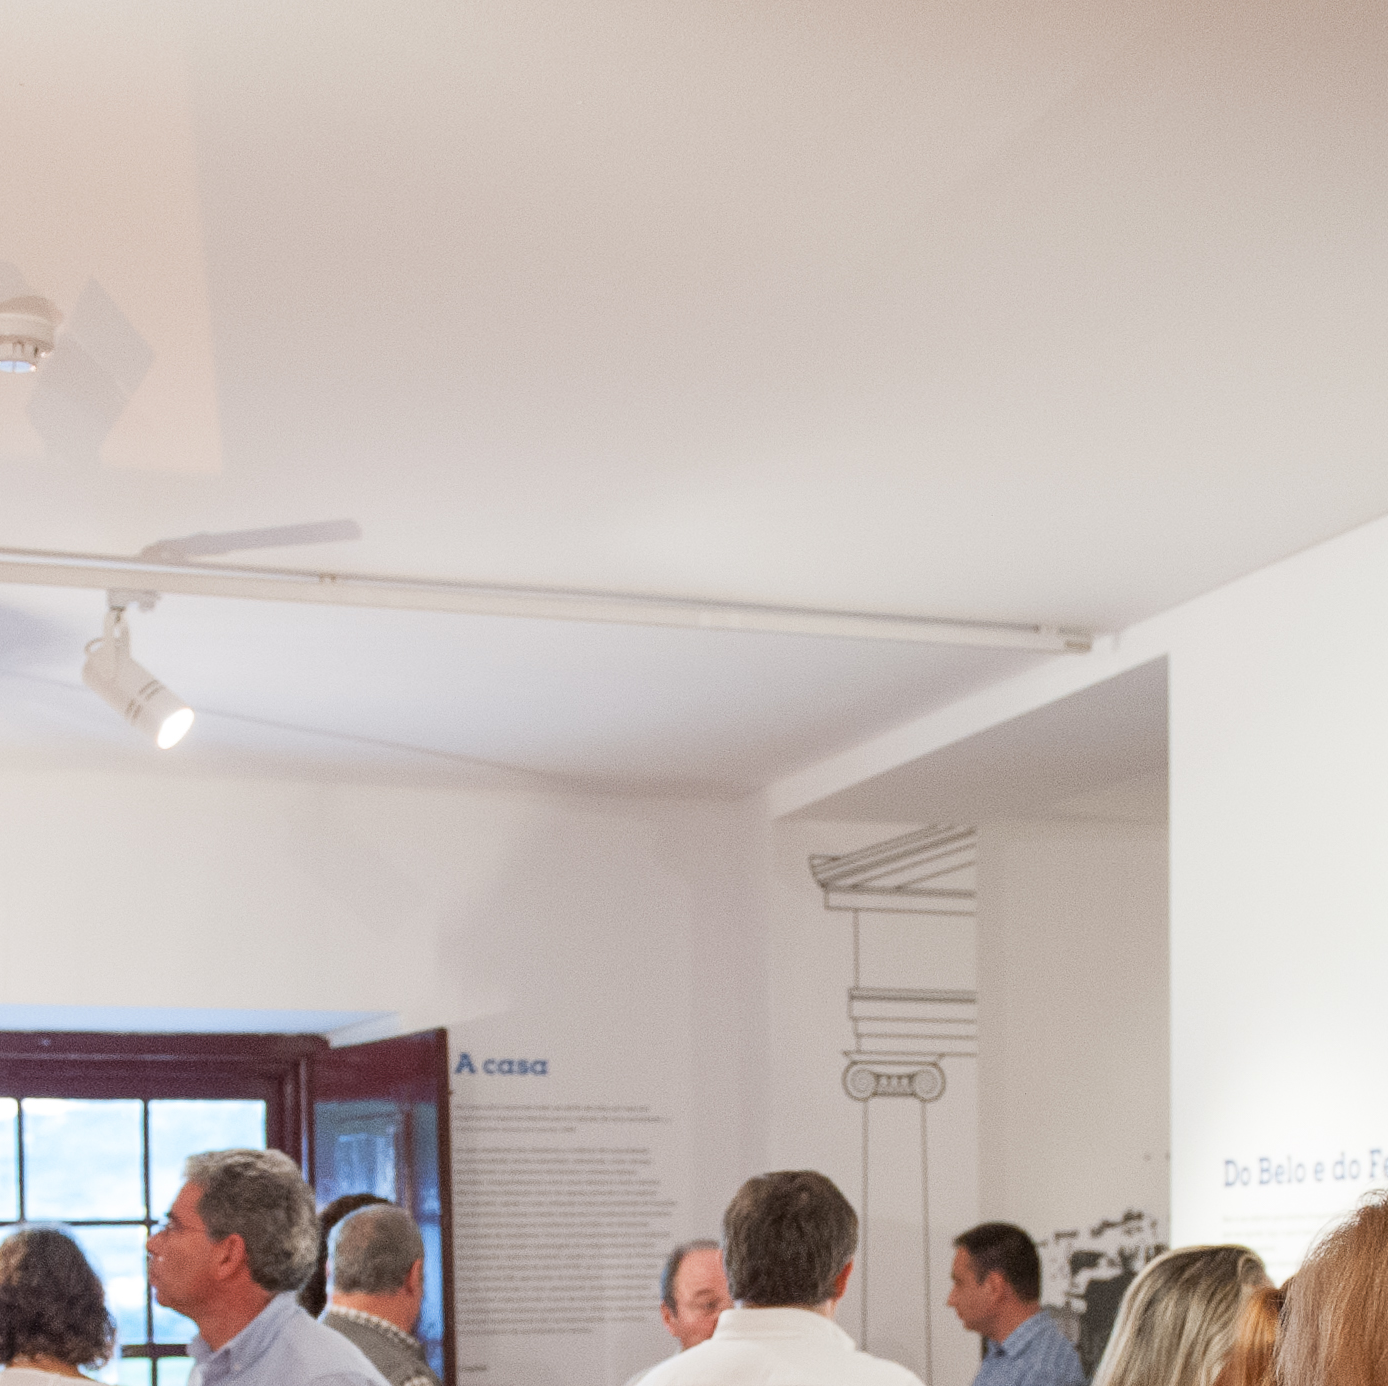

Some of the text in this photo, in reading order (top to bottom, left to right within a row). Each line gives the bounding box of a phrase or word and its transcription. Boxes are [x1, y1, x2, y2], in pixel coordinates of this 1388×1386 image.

[455, 1053, 548, 1076] A casa
[1224, 1160, 1251, 1187] Do
[1259, 1155, 1306, 1185] Belo
[1314, 1162, 1325, 1182] e
[1333, 1152, 1361, 1181] do
